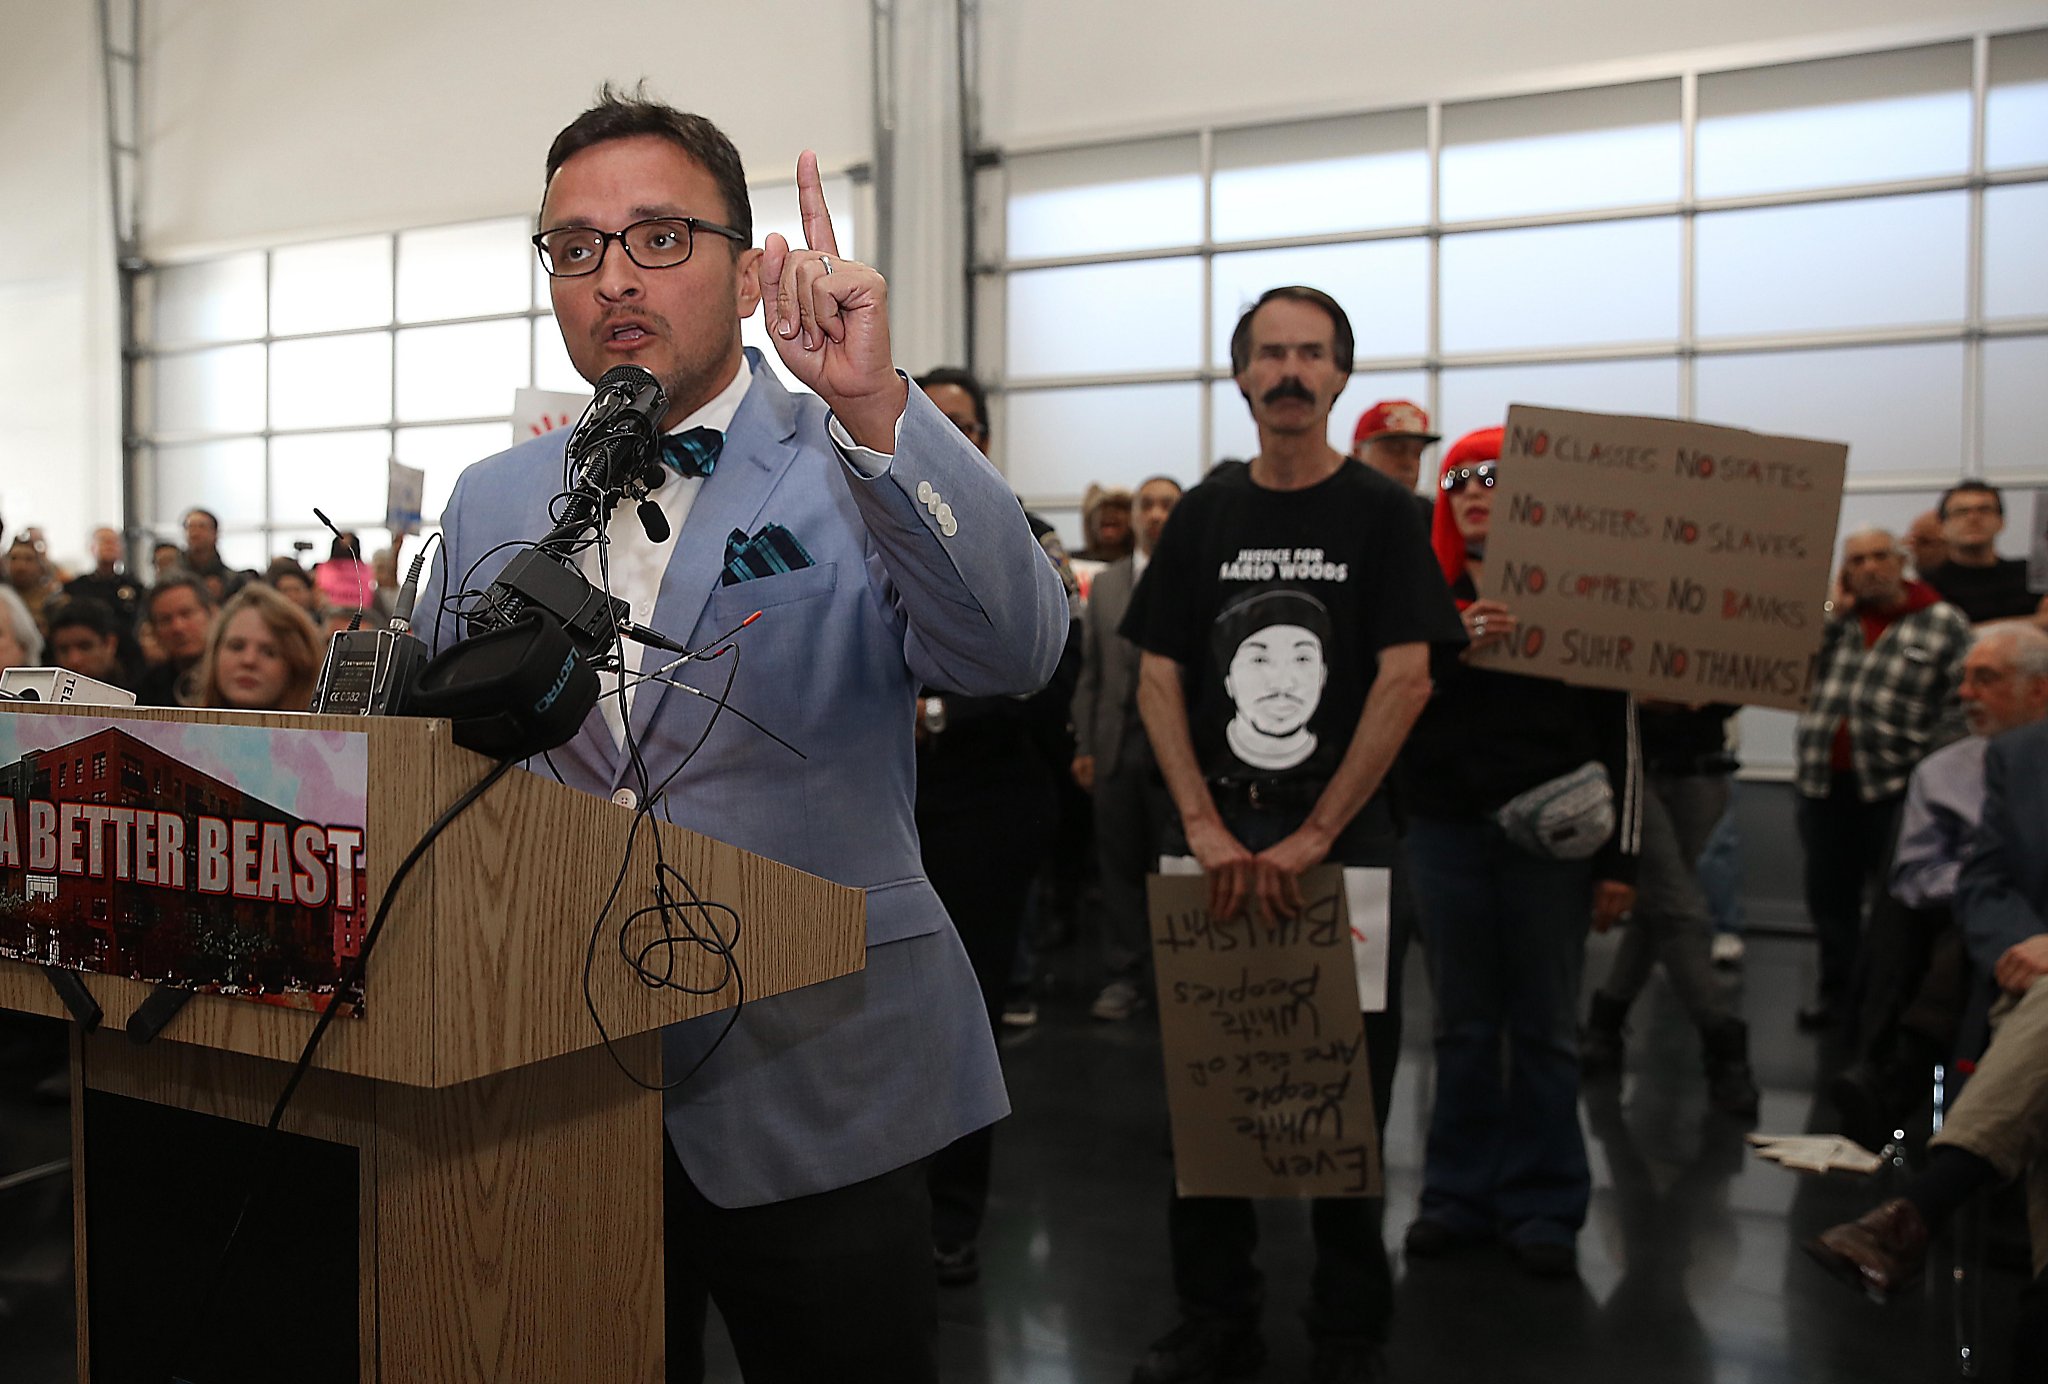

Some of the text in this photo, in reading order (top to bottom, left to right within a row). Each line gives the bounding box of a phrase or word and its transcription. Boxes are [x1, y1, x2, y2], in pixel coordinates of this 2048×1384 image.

[1510, 424, 1813, 490] NO CLASSES NO STATES
[1509, 495, 1808, 560] NO MASTERS NO SLAVES
[1278, 562, 1349, 583] WOODS
[1501, 560, 1808, 629] NO COPPERS NO BANKS
[1559, 627, 1634, 673] SUHR
[1647, 640, 1689, 679] NO
[28, 799, 186, 891] BETTER
[197, 815, 364, 910] BEAST
[1210, 1001, 1321, 1041] White
[1228, 1103, 1344, 1150] White
[1263, 1146, 1370, 1194] Even
